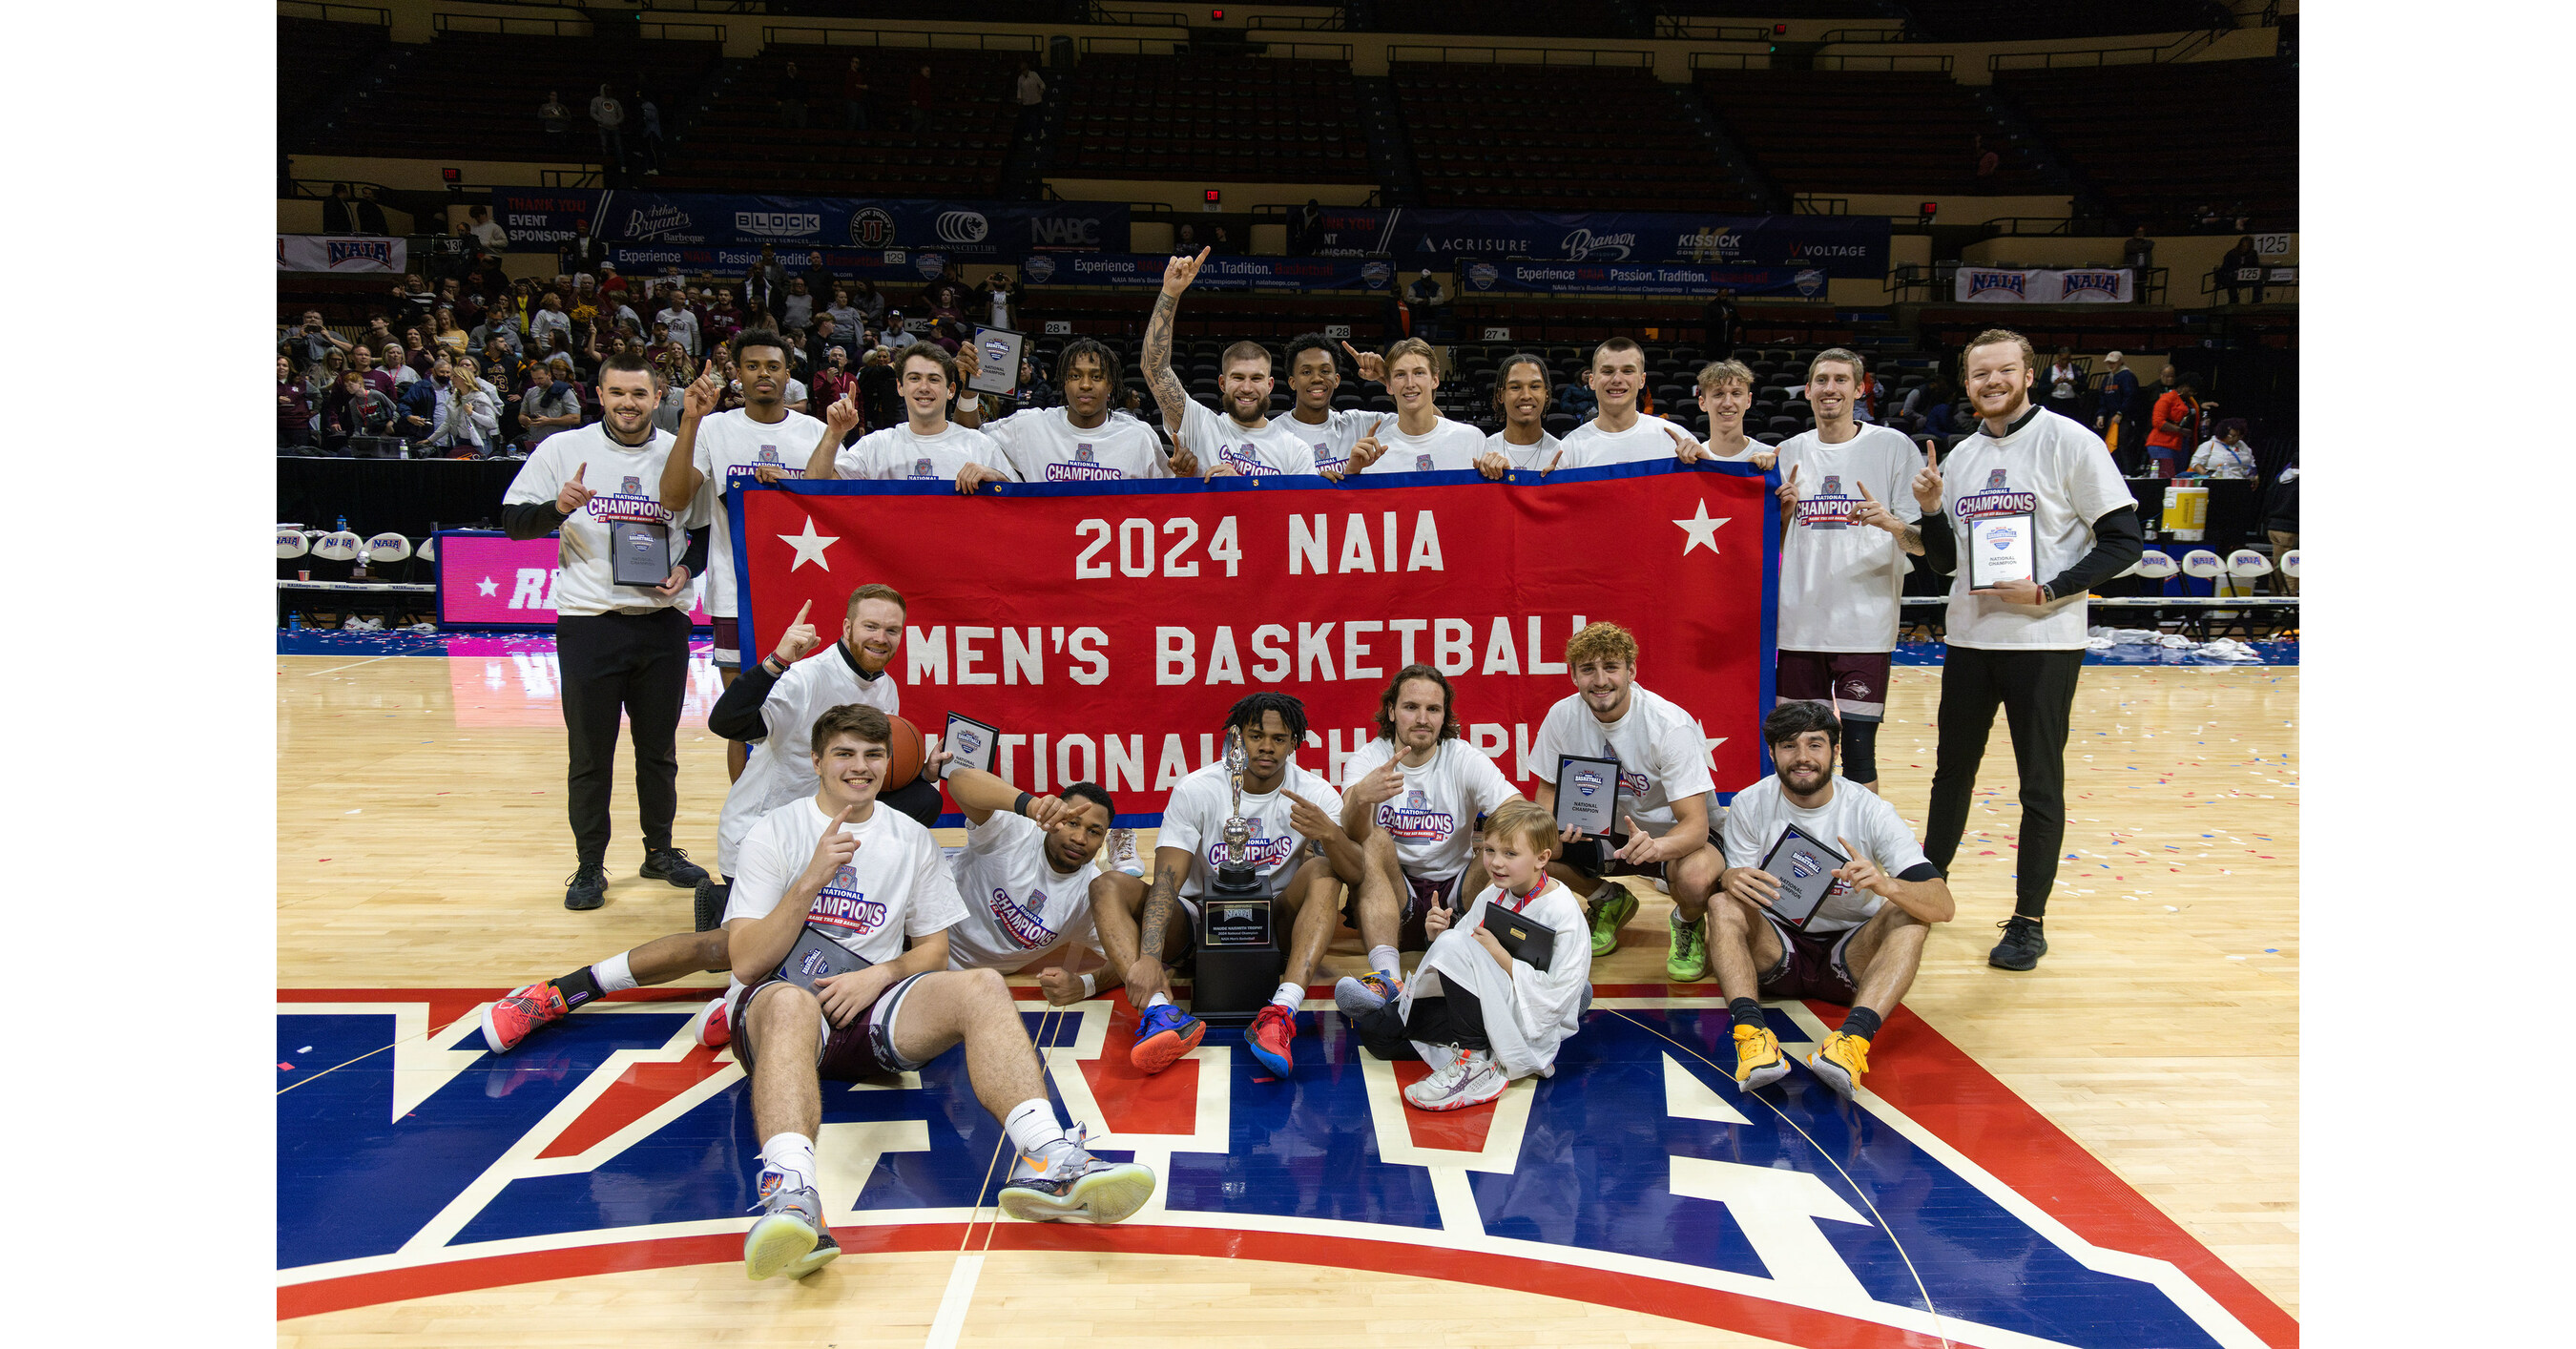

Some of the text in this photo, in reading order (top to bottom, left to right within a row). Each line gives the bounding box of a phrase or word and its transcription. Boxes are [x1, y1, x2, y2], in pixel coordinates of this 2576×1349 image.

[1207, 191, 1218, 200] EXIT
[508, 197, 586, 213] THANK YOU
[648, 204, 678, 218] Arthur
[509, 215, 547, 227] EVENT
[624, 209, 693, 241] Bryant's
[737, 213, 820, 230] BLOCK
[853, 210, 870, 228] JIMMY
[1348, 218, 1375, 231] YOU
[509, 231, 576, 242] SPONSORS
[862, 220, 883, 241] JJ
[1031, 218, 1101, 244] NABC
[663, 233, 706, 244] Barbeque
[1442, 239, 1527, 252] ACRISURE
[1561, 228, 1636, 261] Branson
[1677, 234, 1741, 248] KISSICK
[2257, 236, 2287, 254] 125
[327, 240, 392, 268] NAIA
[619, 250, 681, 264] Experience
[885, 253, 904, 263] 129
[1804, 246, 1867, 258] VOLTAGE
[1074, 259, 1134, 274] Experience
[1220, 261, 1272, 276] Tradition.
[2241, 269, 2258, 279] 125
[1516, 267, 1575, 281] Experience
[1610, 269, 1655, 282] Passion.
[1658, 269, 1709, 283] Tradition.
[1969, 271, 2025, 300] NAIA
[2063, 271, 2118, 300] NAIA
[1047, 324, 1060, 333] 28
[1337, 327, 1349, 337] 28
[1485, 329, 1498, 340] 27
[1234, 453, 1260, 466] NATIONAL
[1316, 457, 1337, 467] ATIONAL
[1047, 465, 1121, 480] CHAMPIONS
[589, 498, 673, 520] CHAMPIONS
[1957, 494, 2035, 515] CHAMPIONS
[371, 538, 402, 551] NAIA
[1075, 510, 1444, 580] 2024 NAIA
[2142, 556, 2168, 568] NAIA
[2192, 556, 2217, 568] NAIA
[2236, 556, 2261, 568] NAIA
[906, 615, 1587, 686] MEN'S BASKETBAL
[956, 756, 975, 766] NATIONAL
[1575, 776, 1602, 784] BASKETBALL
[1380, 806, 1453, 833] CHAMPIONS
[1211, 837, 1292, 863] CHMPIONS
[1792, 852, 1820, 873] BASKETBALL
[1528, 886, 1541, 898] NAIA
[1779, 876, 1803, 895] NATIONAL
[1781, 883, 1801, 900] AMPION
[822, 888, 862, 901] NATIONAL
[810, 895, 885, 926] AMPIONS
[993, 888, 1057, 945] CHAMPIONS
[1224, 908, 1254, 922] NAIA
[802, 949, 821, 974] BASKETBALL
